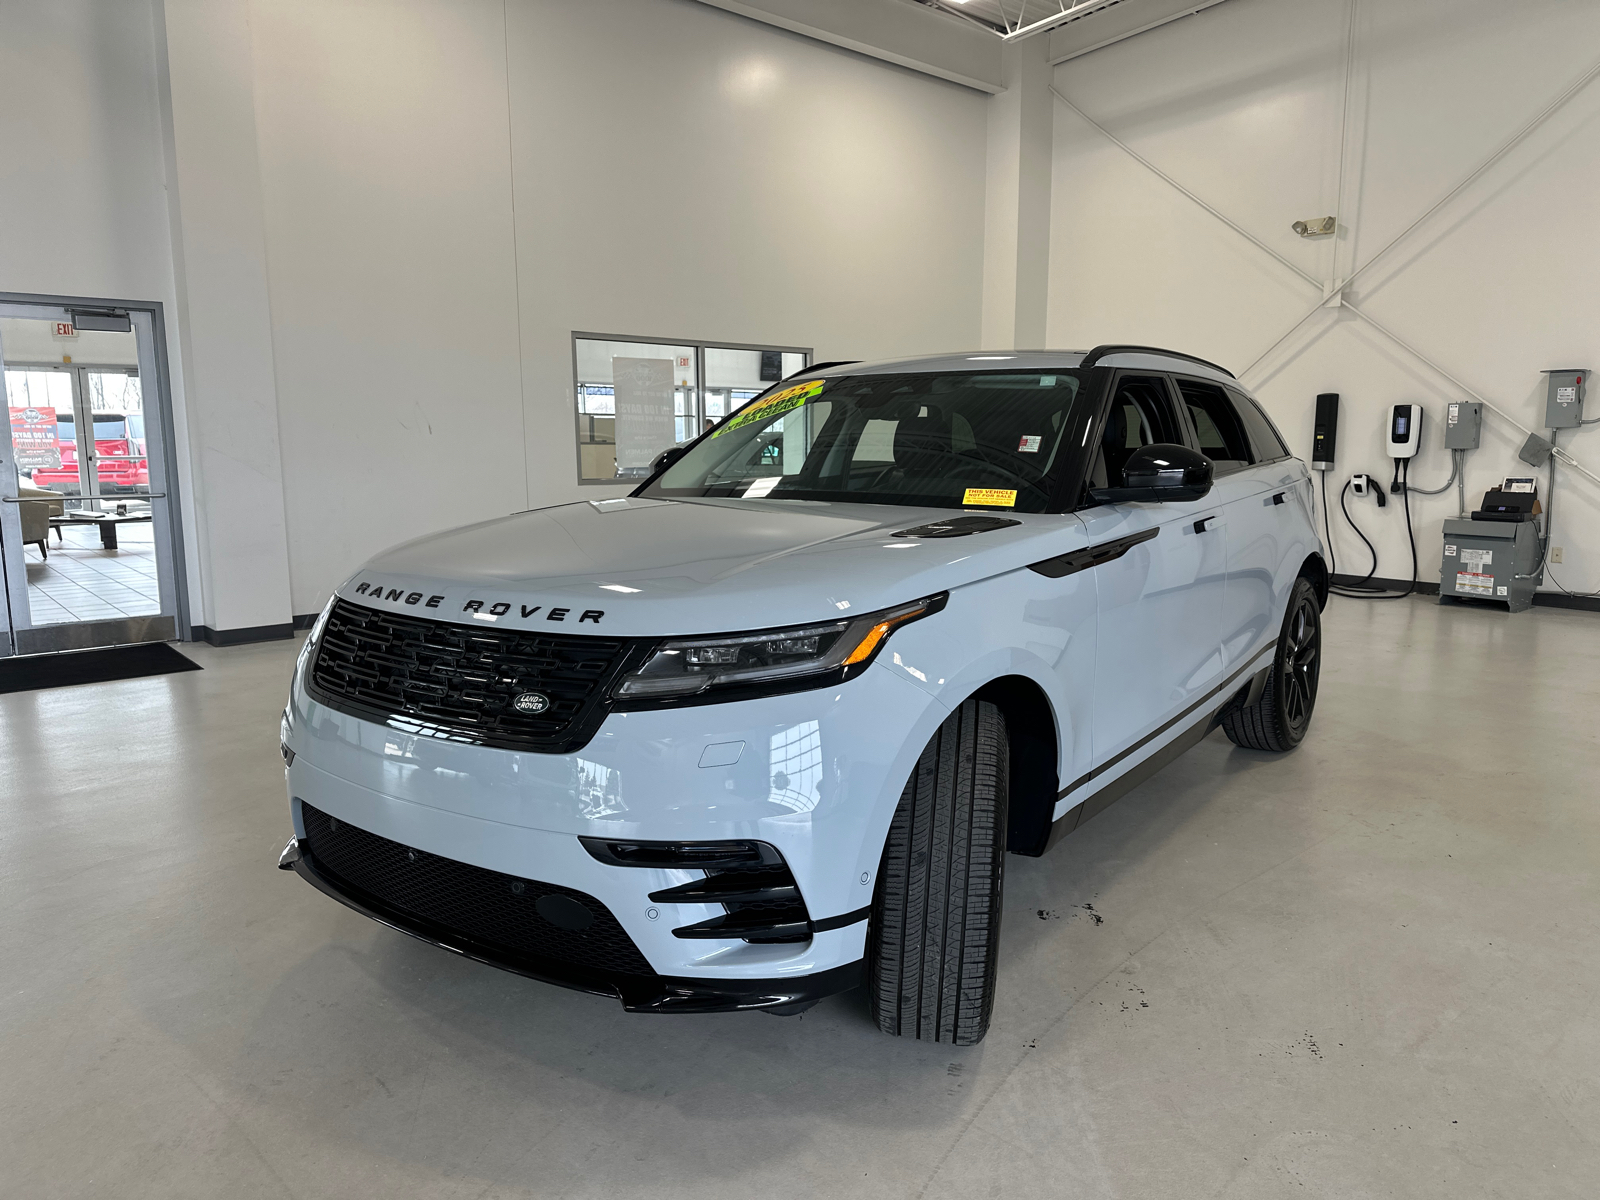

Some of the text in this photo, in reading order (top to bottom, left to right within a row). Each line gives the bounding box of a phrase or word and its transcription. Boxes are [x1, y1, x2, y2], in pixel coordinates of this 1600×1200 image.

[57, 323, 74, 336] EXIT
[355, 582, 605, 624] RANGE ROVER
